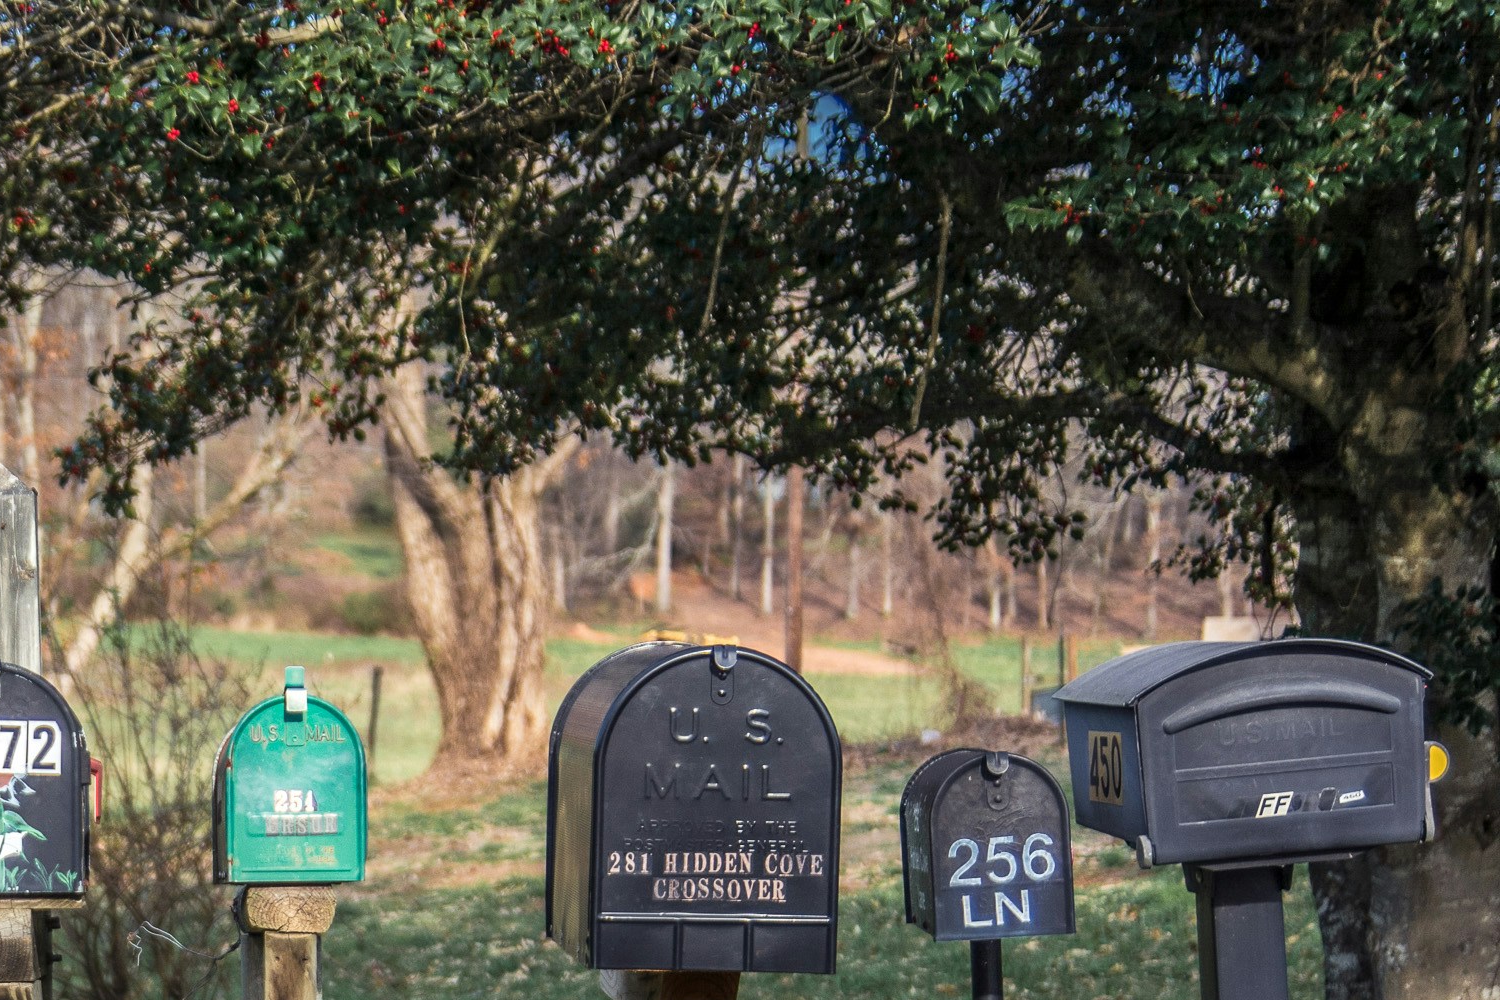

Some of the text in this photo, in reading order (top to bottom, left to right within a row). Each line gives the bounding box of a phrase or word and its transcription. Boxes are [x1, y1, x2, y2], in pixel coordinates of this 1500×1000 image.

[304, 723, 346, 742] MAIL
[1277, 717, 1342, 741] MAIL
[1090, 734, 1122, 799] 450
[644, 762, 791, 800] MAIL
[1258, 794, 1291, 816] FF
[735, 820, 756, 834] BY
[765, 820, 797, 834] THE
[608, 851, 823, 876] 281 HIDDEN COVE
[947, 832, 1056, 888] 256
[653, 878, 786, 901] CROSSOVER
[961, 889, 1032, 928] LN
